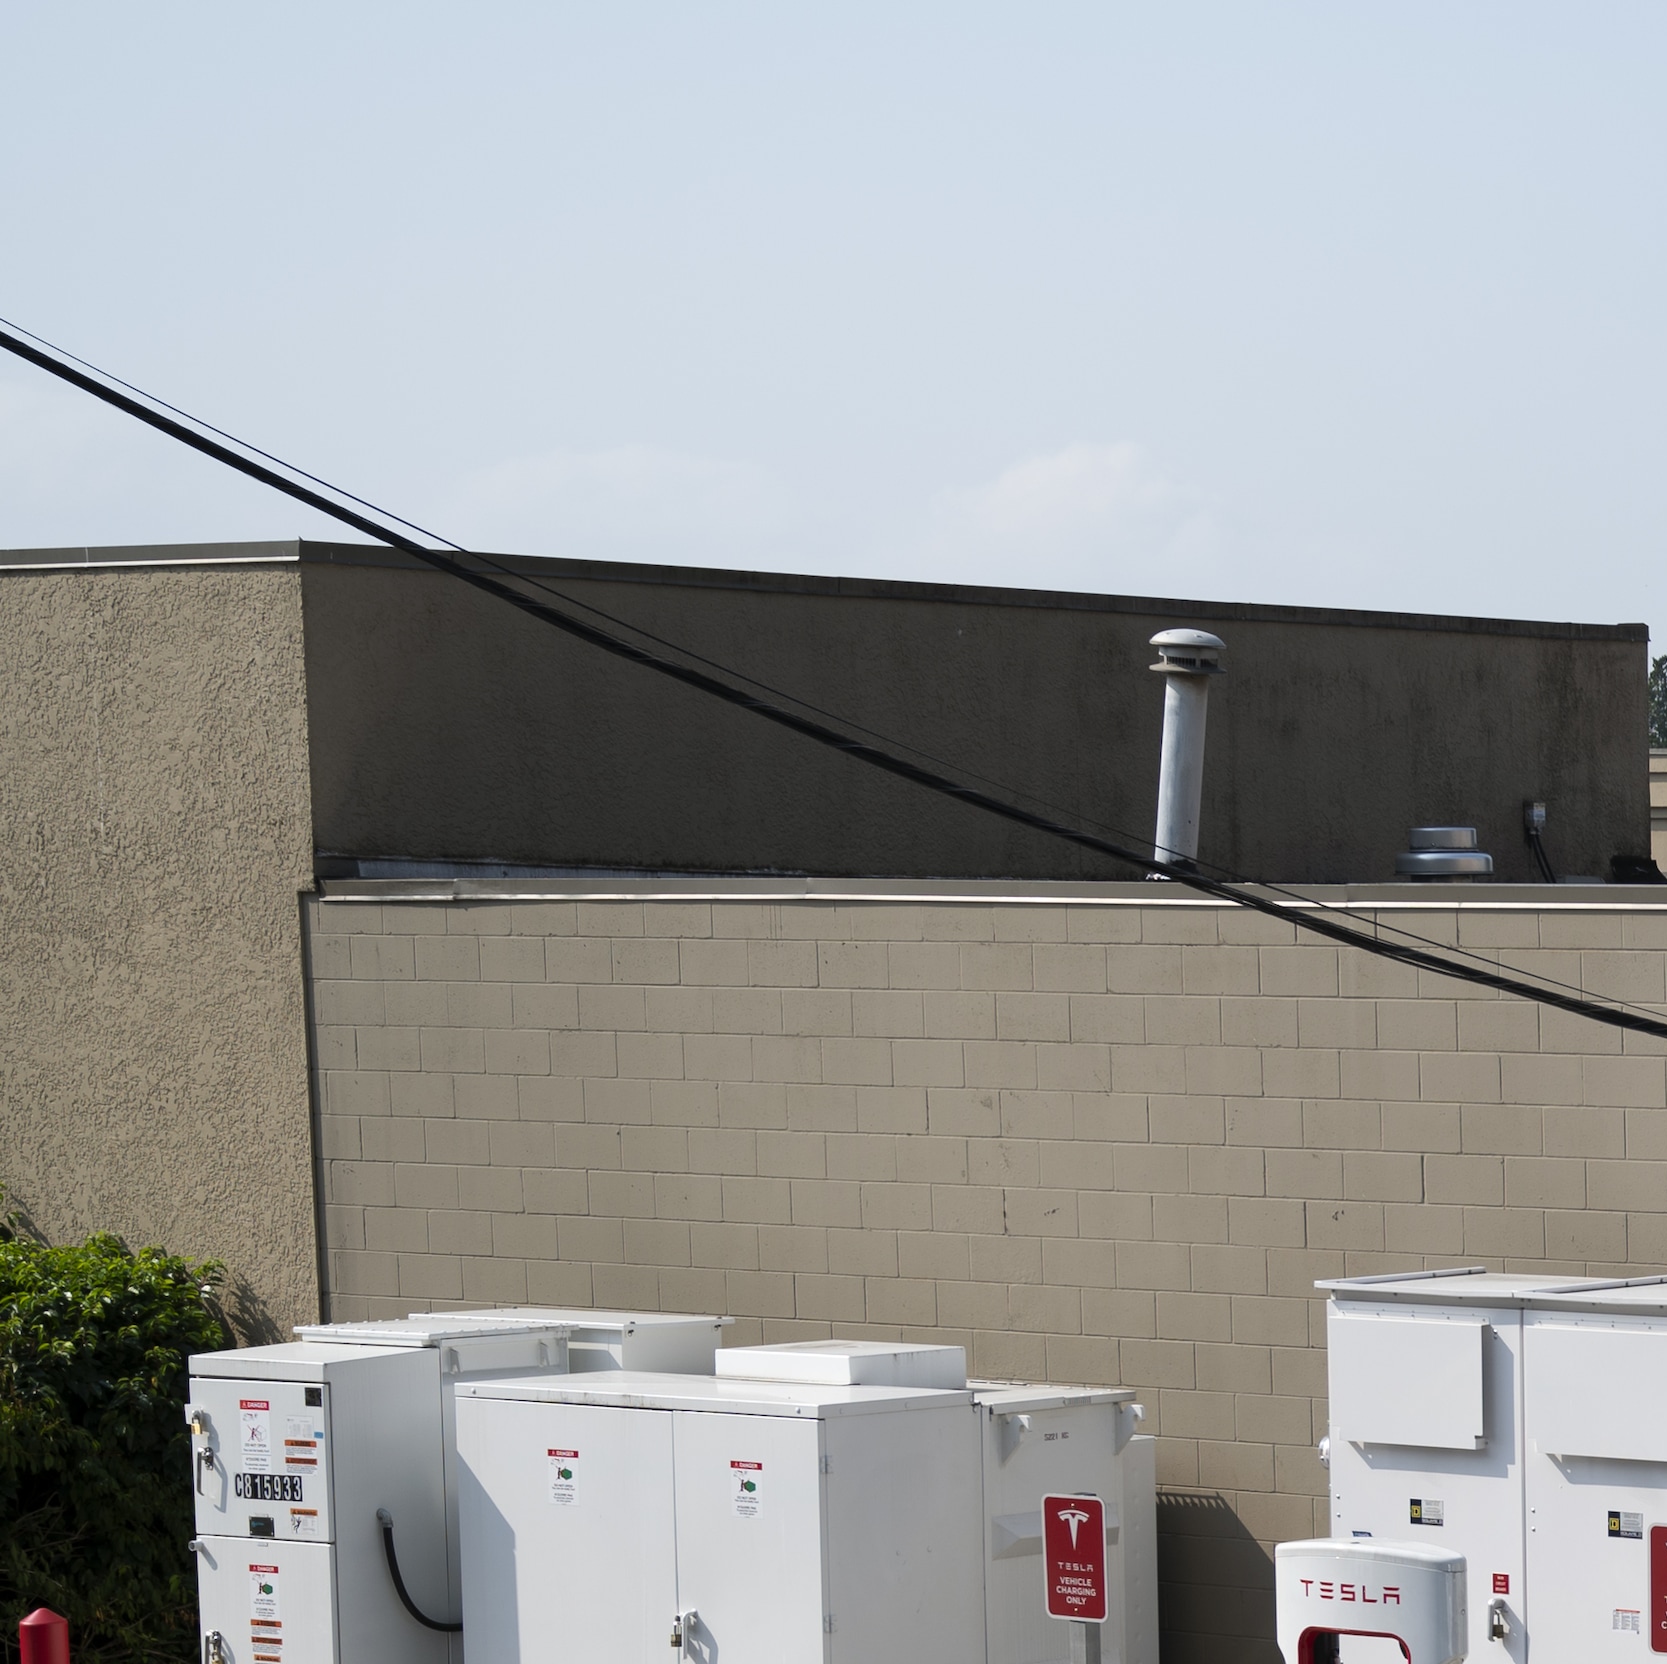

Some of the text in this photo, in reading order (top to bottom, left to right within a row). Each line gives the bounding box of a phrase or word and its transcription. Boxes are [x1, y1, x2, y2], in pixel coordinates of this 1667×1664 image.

[235, 1473, 302, 1501] C815933
[1057, 1561, 1094, 1572] TESLA
[1059, 1576, 1092, 1587] VEHICLE
[1056, 1586, 1097, 1597] CHARGING
[1300, 1579, 1401, 1605] TESLA
[1066, 1595, 1087, 1605] ONLY
